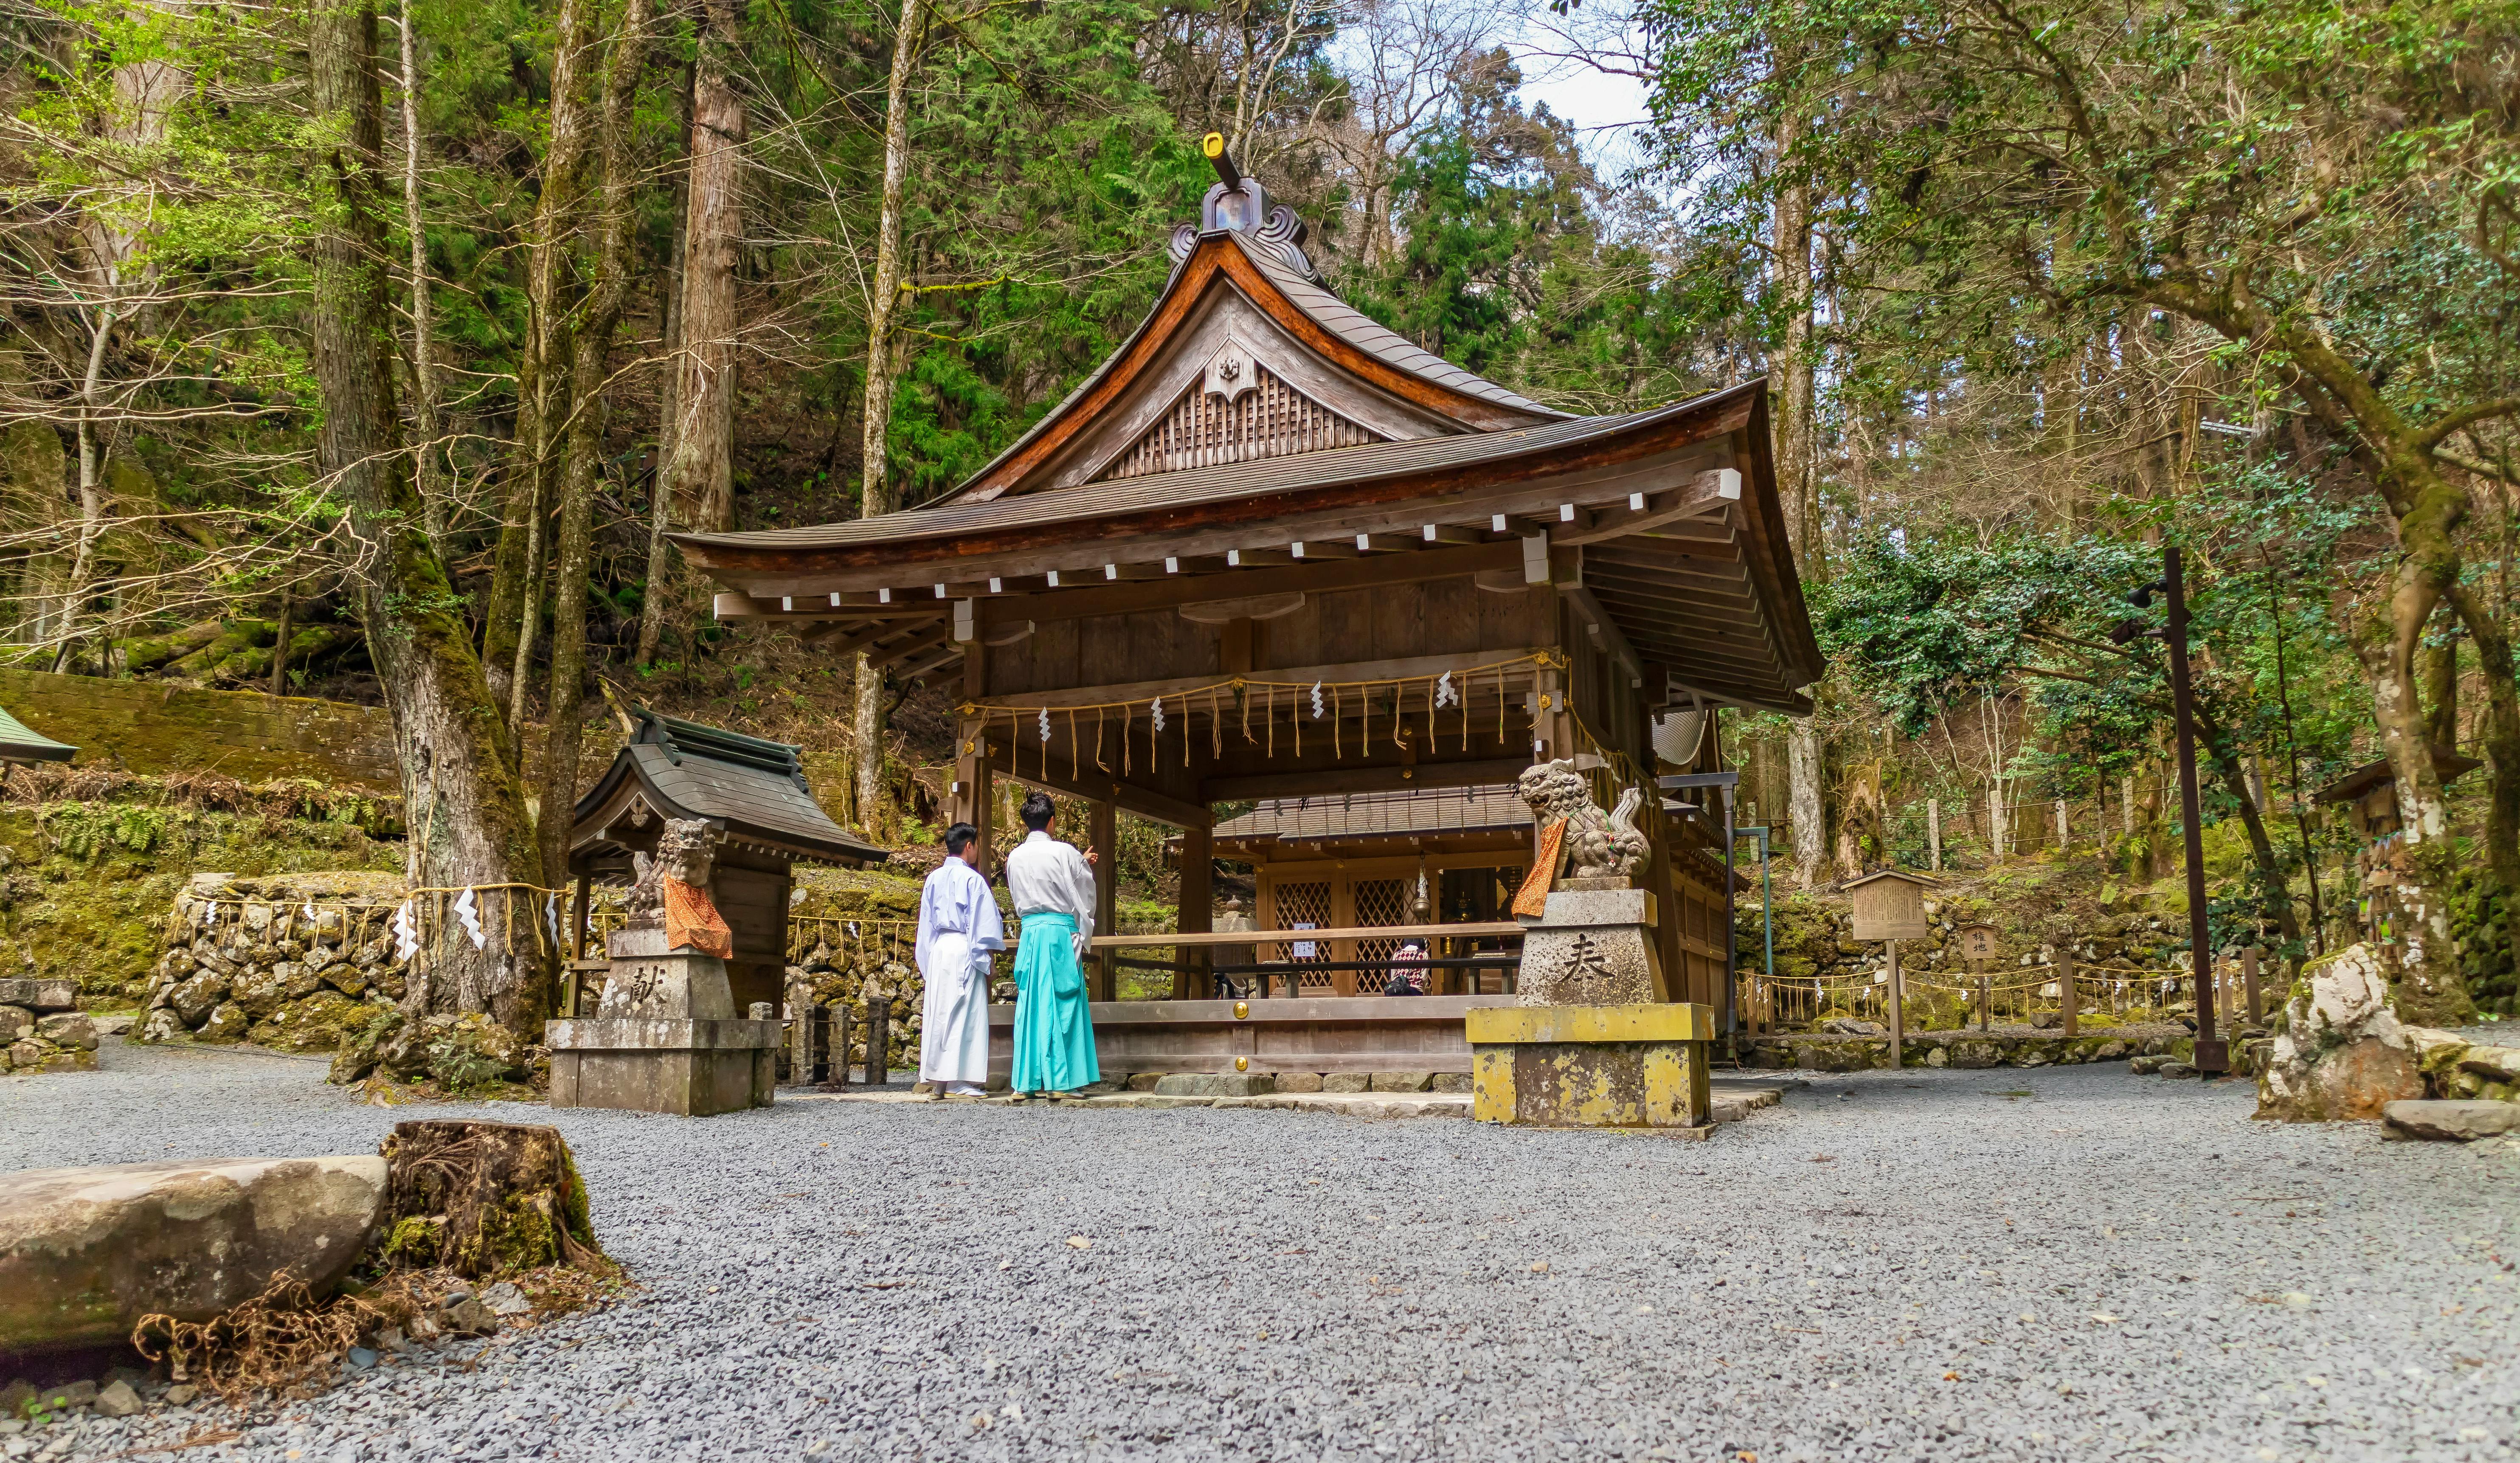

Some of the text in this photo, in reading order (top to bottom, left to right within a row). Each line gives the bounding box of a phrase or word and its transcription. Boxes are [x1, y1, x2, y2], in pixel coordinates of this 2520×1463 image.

[1558, 933, 1616, 982] 奉
[1972, 931, 1988, 951] 権地
[630, 965, 667, 1004] 献
